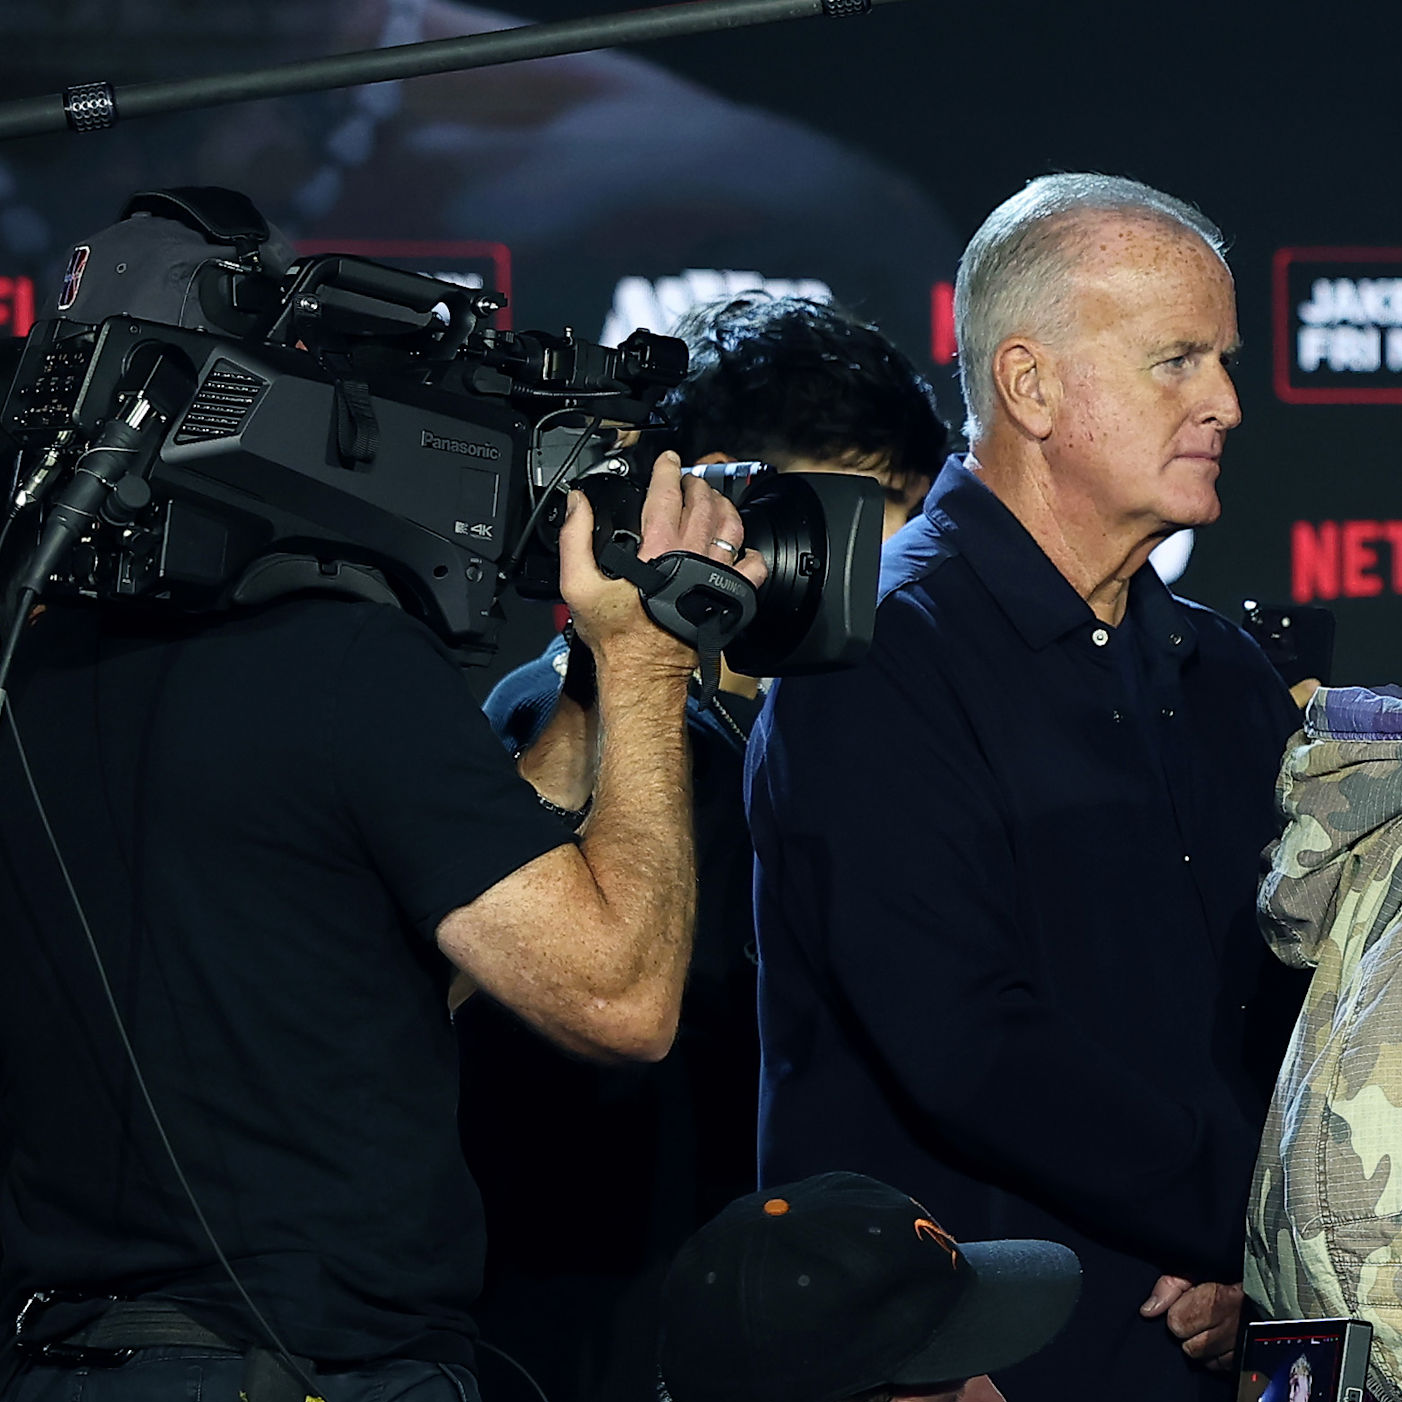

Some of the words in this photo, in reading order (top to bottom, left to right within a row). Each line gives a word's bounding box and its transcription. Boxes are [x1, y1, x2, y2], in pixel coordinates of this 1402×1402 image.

[1299, 326, 1381, 371] FRI
[421, 430, 499, 460] Panasonic
[470, 523, 493, 537] 4K
